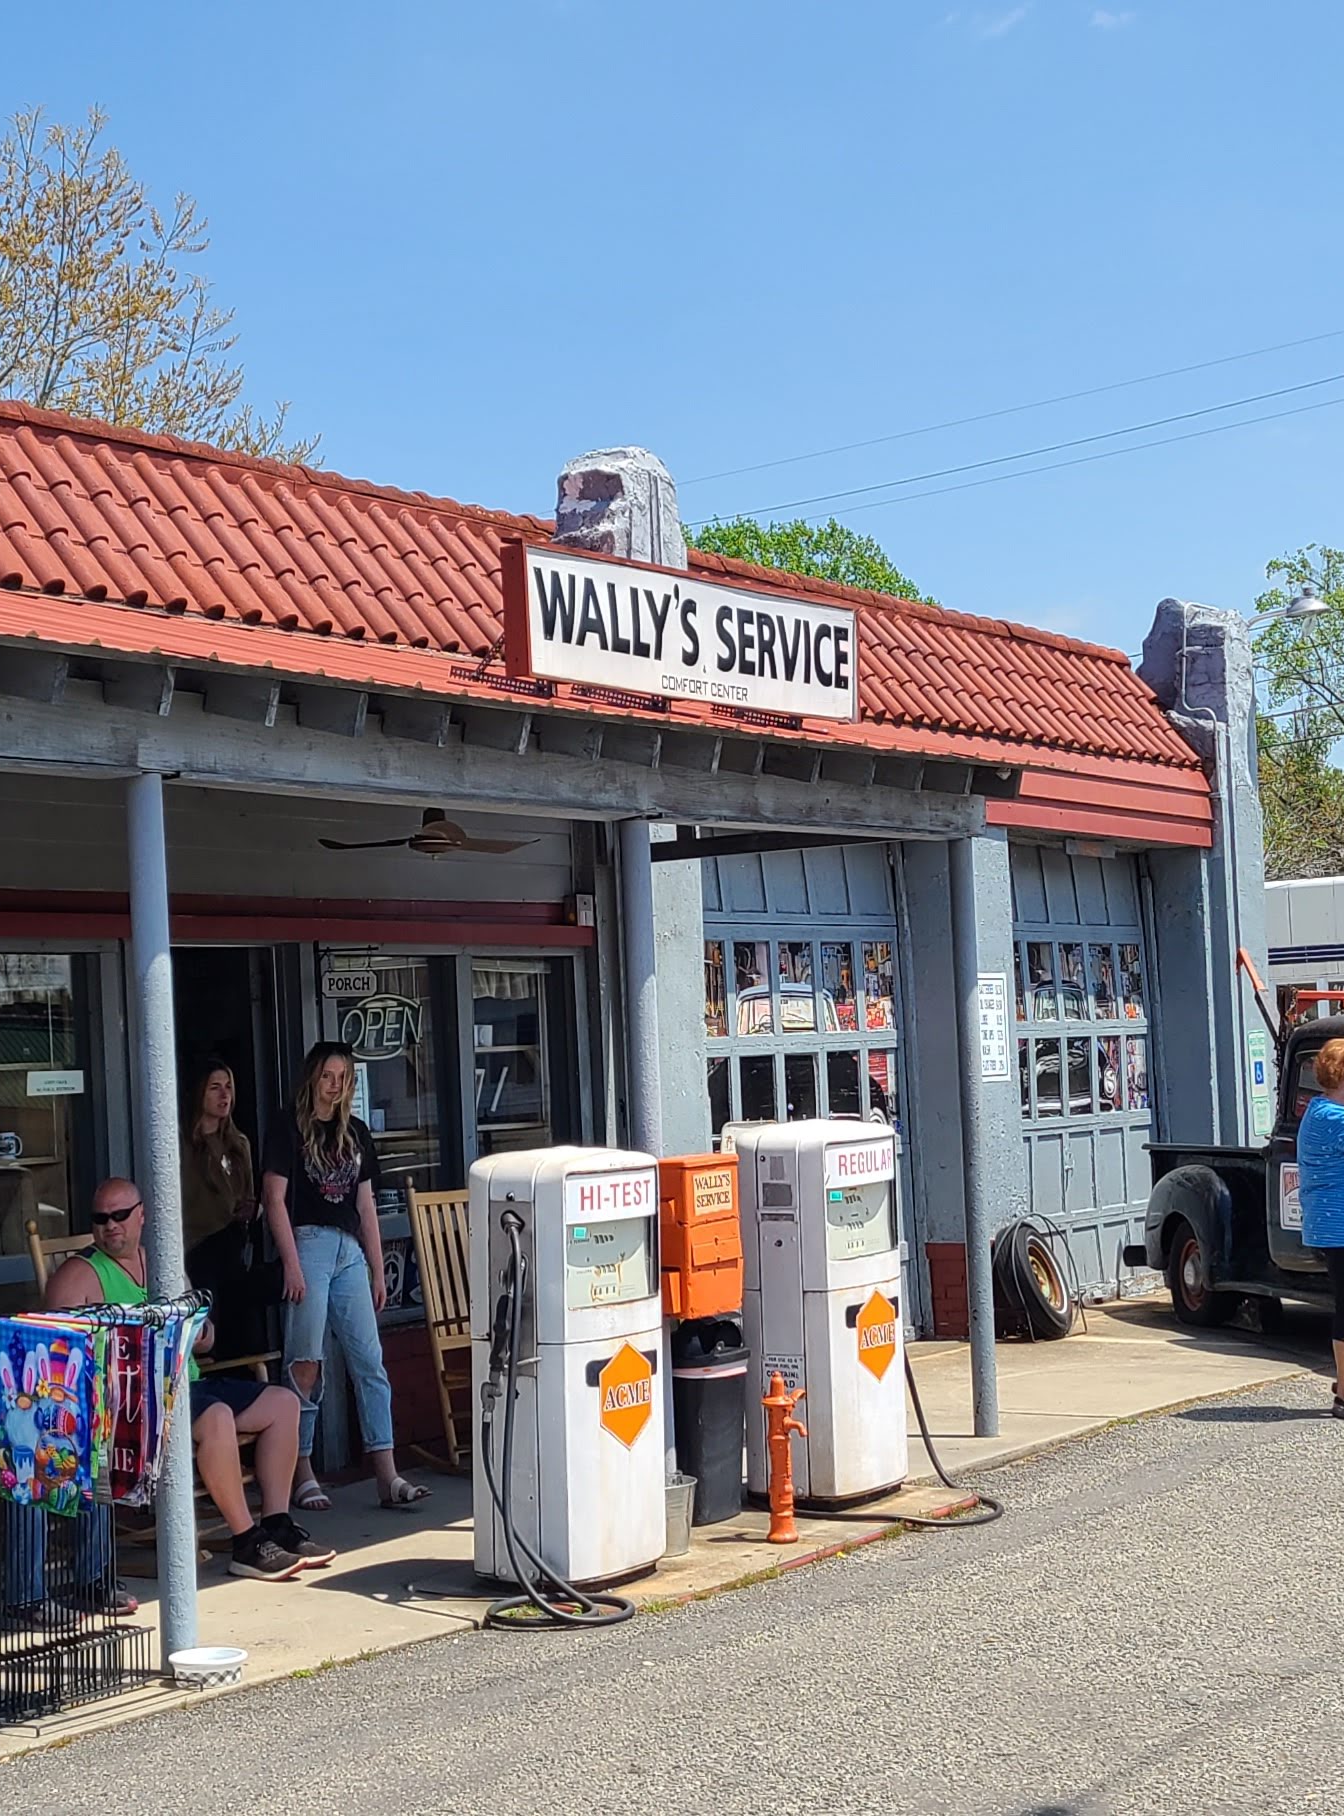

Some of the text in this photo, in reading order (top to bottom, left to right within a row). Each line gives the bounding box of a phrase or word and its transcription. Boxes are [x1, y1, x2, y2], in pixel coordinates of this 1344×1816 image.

[533, 567, 849, 690] WALLY'S SERVICE
[661, 674, 748, 702] COMFORT CENTER
[327, 977, 370, 992] PORCH
[342, 1006, 422, 1049] OPEN
[838, 1147, 892, 1177] REGULAR
[580, 1179, 651, 1212] HI-TEST
[694, 1173, 731, 1191] WALLY'S
[696, 1190, 731, 1209] SERVICE
[861, 1322, 895, 1349] ACME
[605, 1380, 650, 1410] ACME
